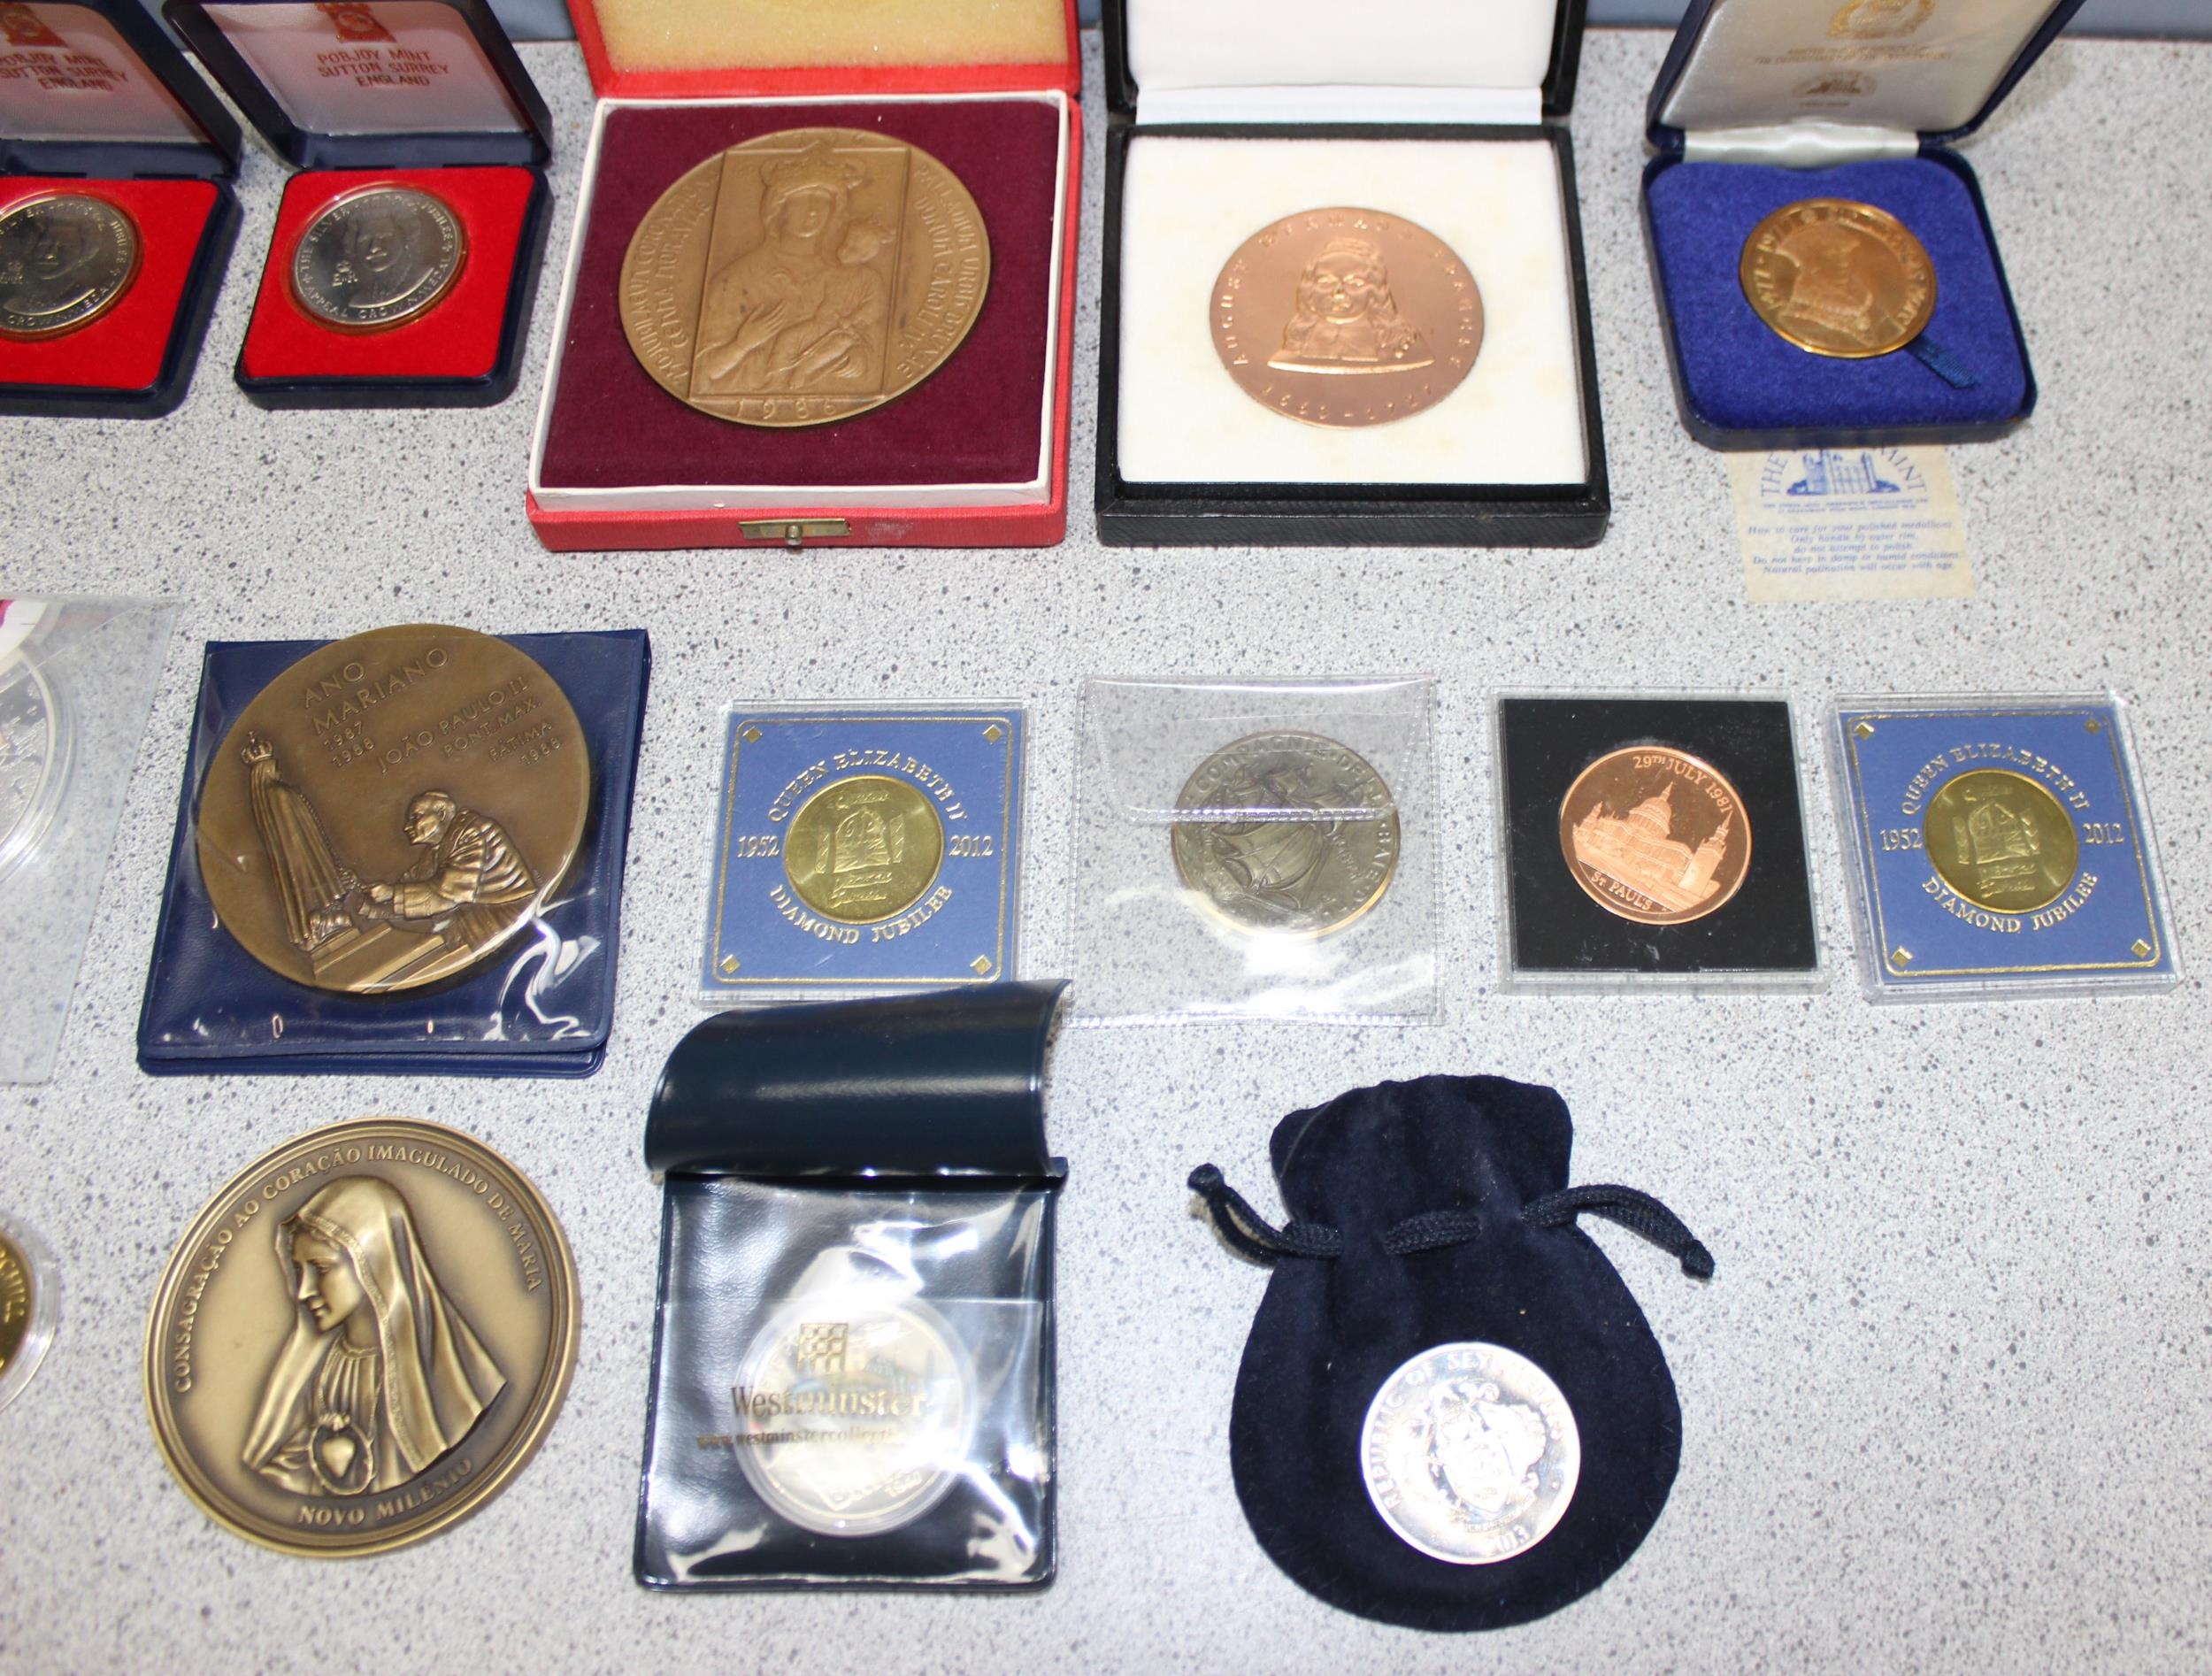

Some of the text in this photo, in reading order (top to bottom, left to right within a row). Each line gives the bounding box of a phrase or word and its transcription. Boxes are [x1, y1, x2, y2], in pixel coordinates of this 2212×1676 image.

[317, 49, 431, 65] POBJOY MINT
[318, 62, 449, 77] SUTTON SURREY
[37, 77, 113, 91] ENGLAND
[356, 74, 431, 88] ENGLAND
[736, 397, 837, 420] 1986
[1858, 521, 1897, 533] polished
[1829, 543, 1866, 553] attempt
[1832, 553, 1857, 563] damp
[1763, 565, 1801, 574] Natural
[304, 662, 365, 708] ANO
[311, 647, 449, 736] MARIANO
[323, 720, 365, 751] 1987
[376, 675, 531, 774] JOÃO PAULO II
[331, 735, 376, 768] 1988
[519, 736, 563, 767] 1988
[768, 759, 829, 823] QUEEN
[833, 749, 956, 806] ELIZABETH
[1665, 759, 1709, 786] JULY
[1704, 781, 1733, 814] 1981
[1901, 754, 1951, 816] QUEEN
[1949, 742, 2075, 793] ELIZABETH
[736, 834, 780, 858] 1952
[948, 834, 994, 858] 2012
[1878, 827, 1923, 852] 1952
[2082, 822, 2125, 845] 2012
[1608, 881, 1653, 911] PAUL'S
[1922, 871, 2099, 934] DIAMOND JUBILEE
[770, 884, 953, 946] DIAMOND JUBILEE
[175, 1144, 545, 1395] CONSAGRAÇÃO AO CORAÇÃO IMACULADO DE MARIA
[730, 1384, 929, 1418] Westminster
[1369, 1389, 1406, 1510] REPUBLIC
[297, 1504, 366, 1527] NOVO
